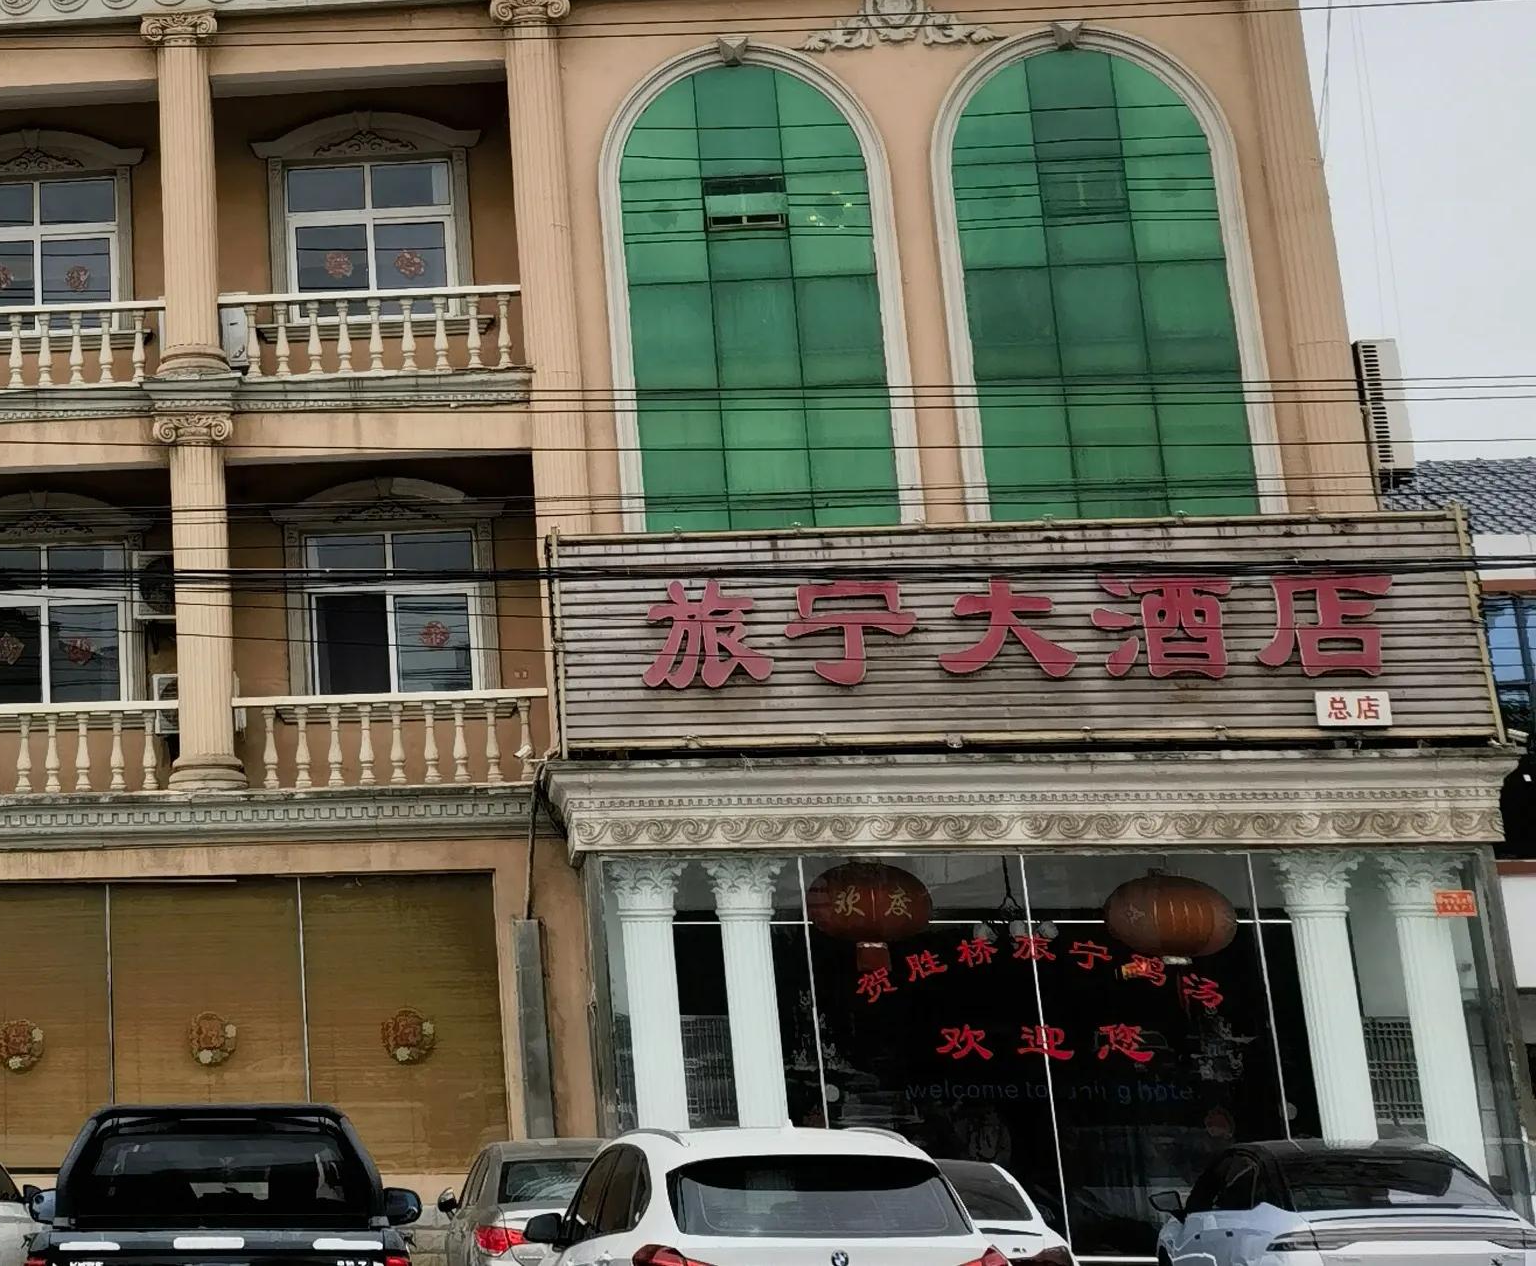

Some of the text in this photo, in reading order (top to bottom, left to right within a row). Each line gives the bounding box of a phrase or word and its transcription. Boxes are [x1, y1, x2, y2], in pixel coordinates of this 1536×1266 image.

[642, 575, 1394, 690] 旅宁大酒店
[1328, 695, 1381, 720] 总店
[935, 1024, 1155, 1062] 欢迎您
